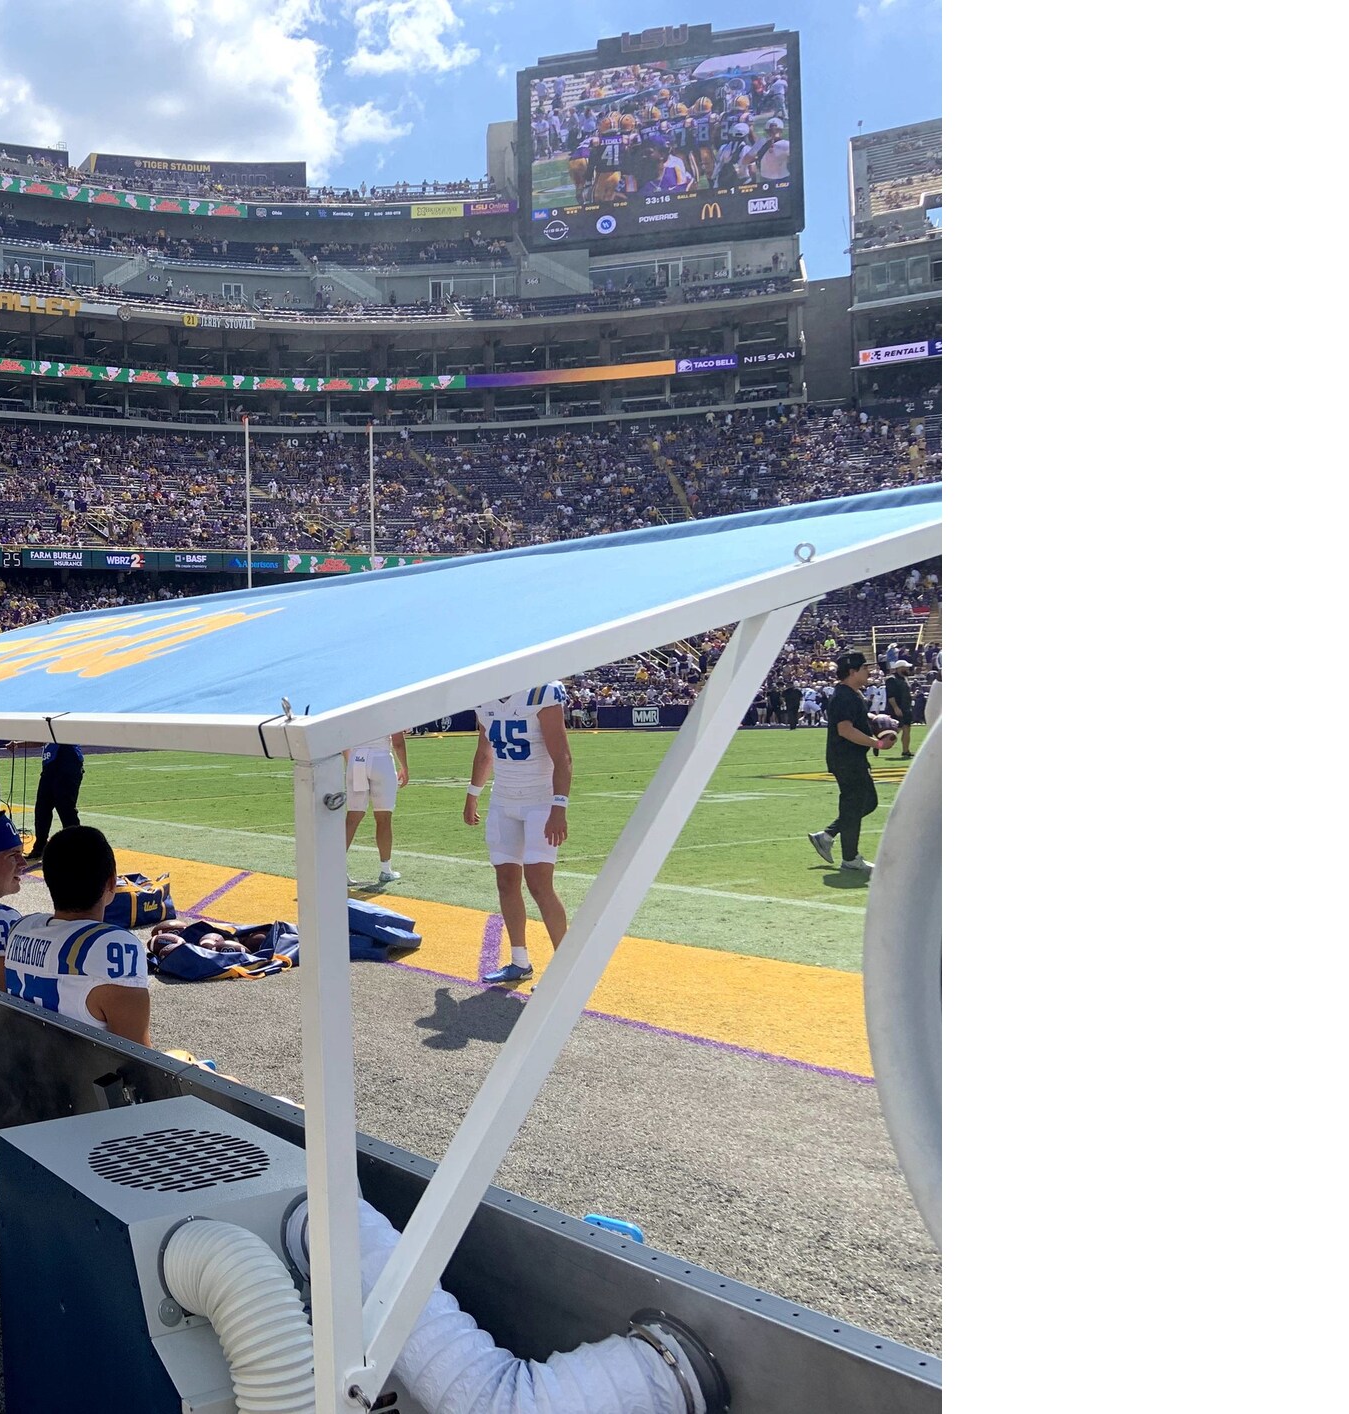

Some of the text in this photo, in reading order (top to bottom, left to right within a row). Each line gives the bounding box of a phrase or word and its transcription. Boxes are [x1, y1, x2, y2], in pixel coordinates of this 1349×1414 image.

[621, 23, 689, 53] LSU
[142, 160, 211, 172] TIGER STADIUM
[645, 195, 671, 205] 33:16
[750, 200, 776, 211] MMR
[471, 203, 510, 212] LSU Online
[639, 212, 679, 223] POWERADE
[543, 226, 570, 234] NISSAN
[186, 315, 195, 325] 21
[201, 316, 256, 330] JERRY STOVALL
[884, 345, 925, 357] RENTALS
[693, 358, 736, 369] TACO BELL
[743, 351, 796, 364] NISSAN
[3, 553, 21, 567] 25
[30, 551, 83, 559] FARM BUREAU
[106, 553, 141, 568] WBRZ 2
[186, 555, 207, 563] BASF
[634, 710, 658, 723] MMR
[489, 720, 531, 760] 45
[143, 900, 159, 912] Ucla
[7, 933, 52, 969] FIREBAUGH
[106, 942, 138, 979] 97
